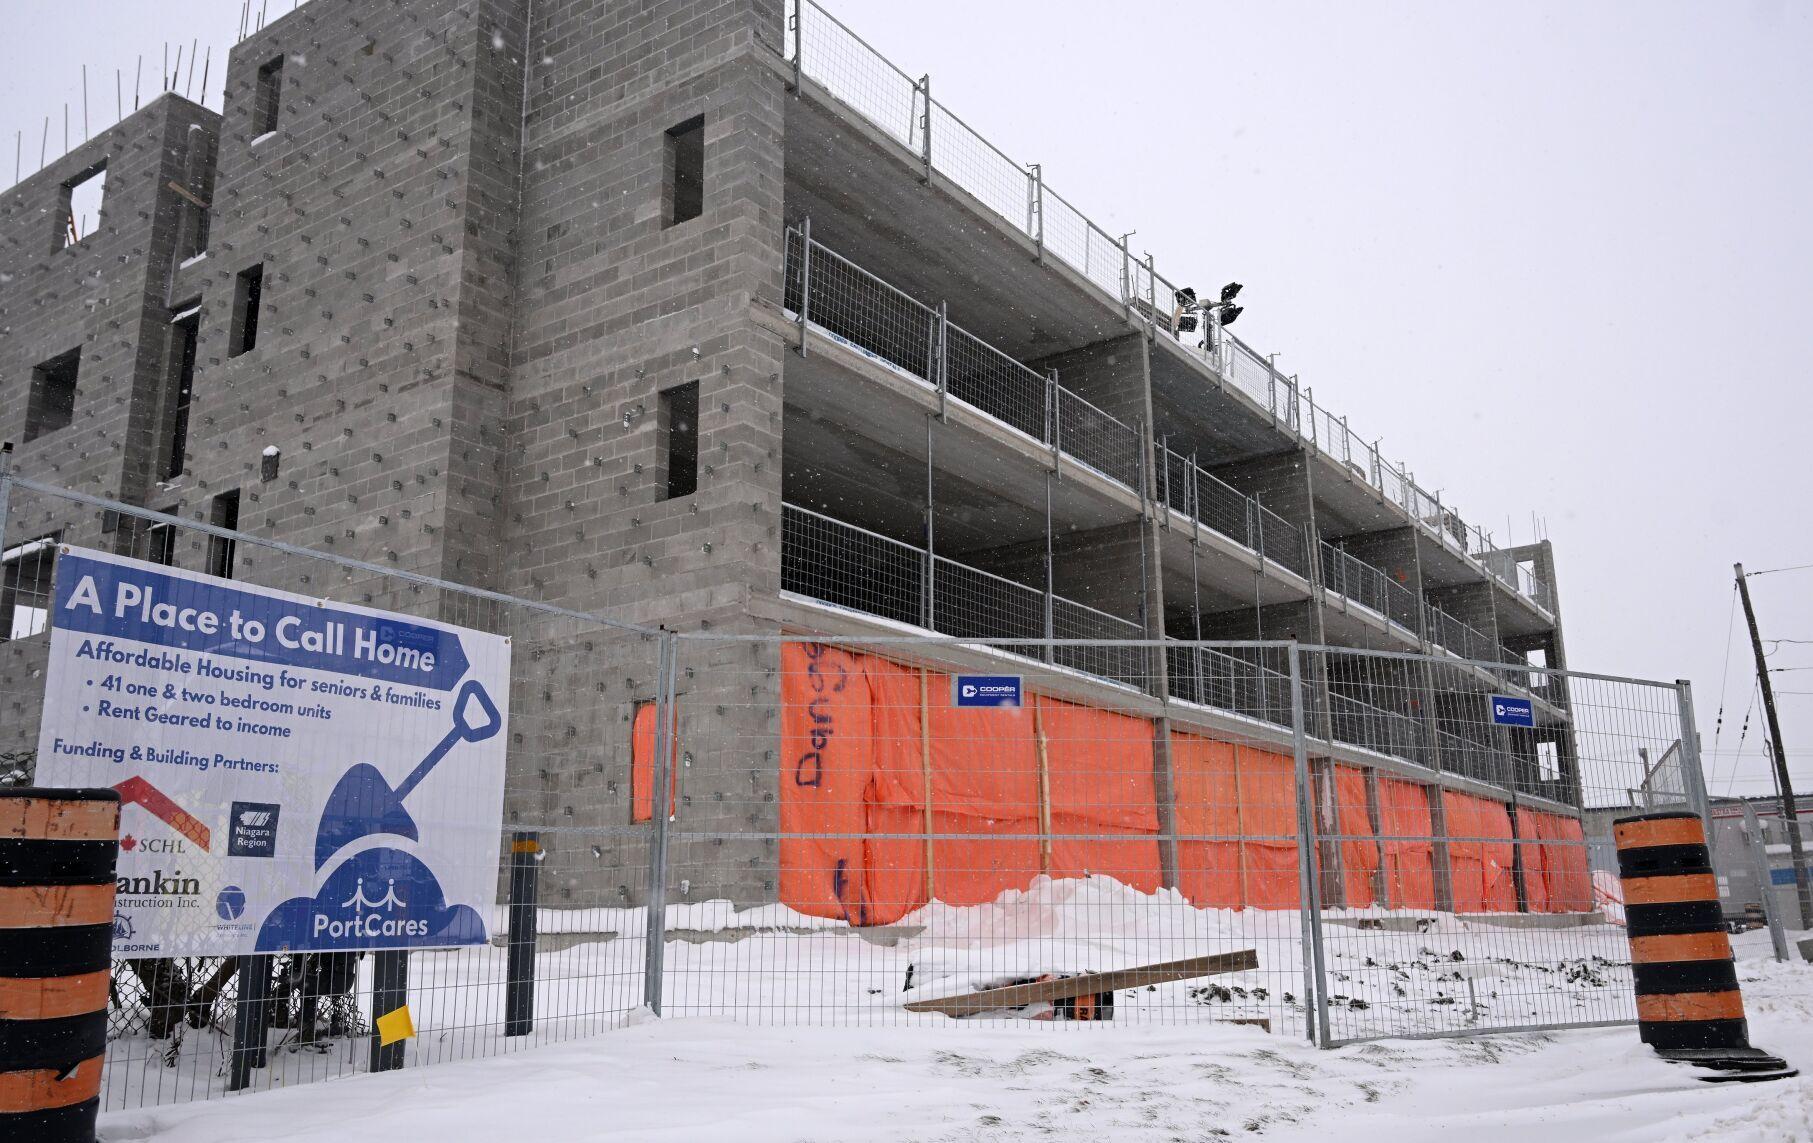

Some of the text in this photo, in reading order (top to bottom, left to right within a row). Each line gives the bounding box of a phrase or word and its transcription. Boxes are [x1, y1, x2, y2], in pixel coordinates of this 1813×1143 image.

[65, 575, 435, 672] A Place to Call Home
[76, 639, 441, 710] Affordable Housing for seniors & families
[101, 675, 332, 720] 41 one & two bedroom units
[98, 700, 291, 738] Rent Geared to income
[53, 738, 280, 774] Funding & Building Partners:
[235, 826, 270, 838] Niagara
[237, 838, 267, 848] Region
[138, 838, 186, 854] SCHL
[115, 870, 200, 895] ankin
[114, 896, 200, 908] struction Inc.
[313, 913, 428, 938] PortCares
